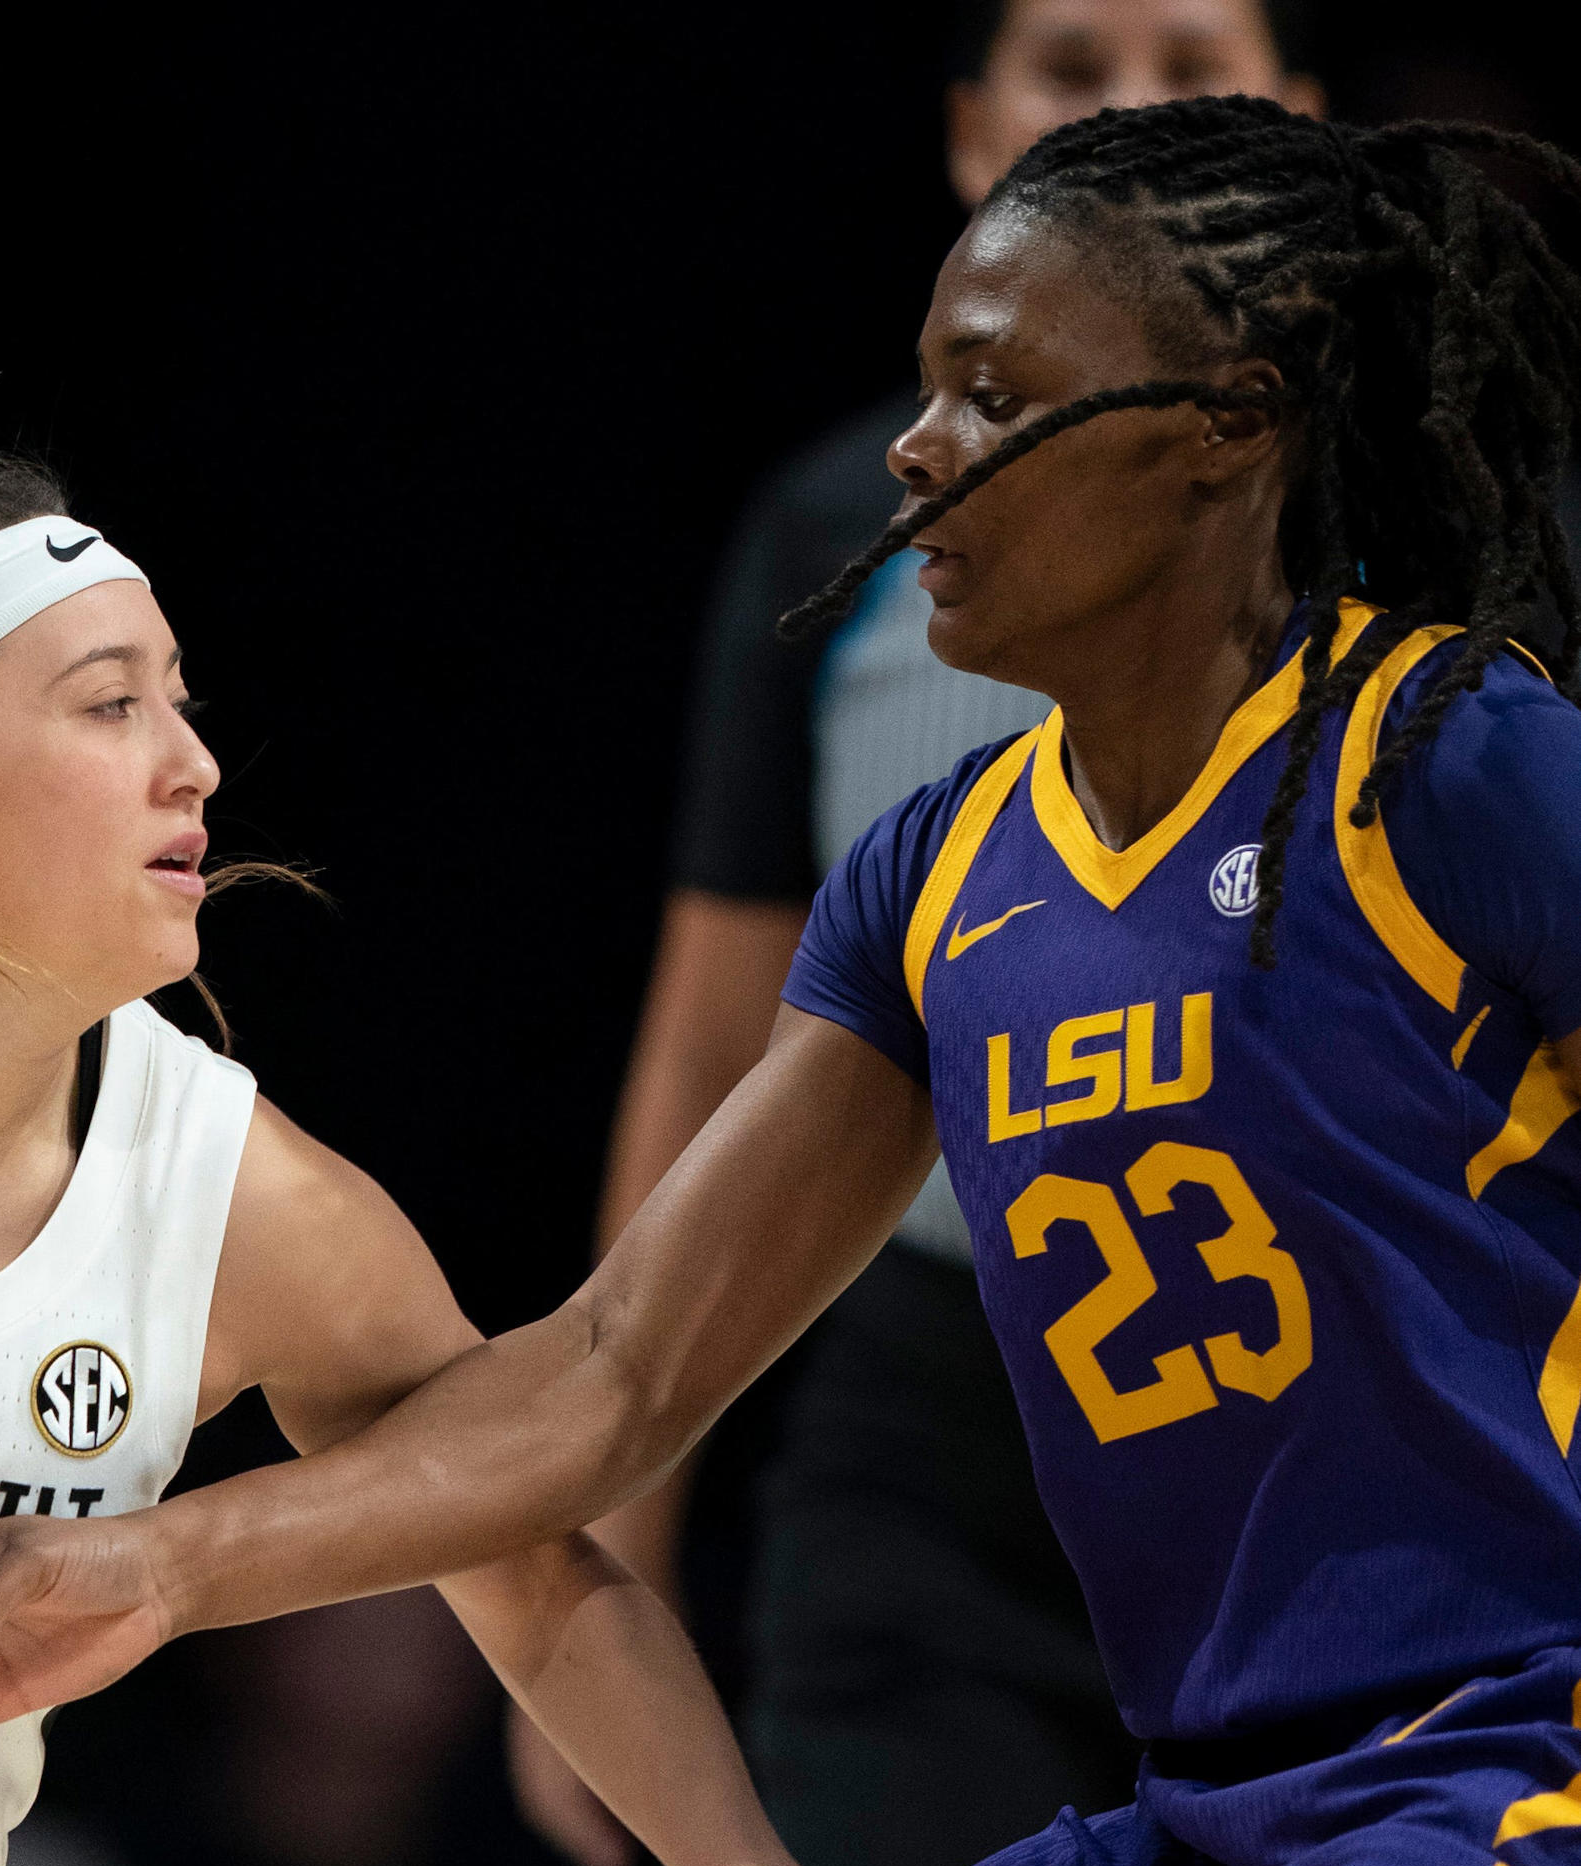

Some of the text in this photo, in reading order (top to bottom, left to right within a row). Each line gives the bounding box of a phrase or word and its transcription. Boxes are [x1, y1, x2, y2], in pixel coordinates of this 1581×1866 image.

[987, 992, 1214, 1143] LSU
[1005, 1141, 1313, 1443] 23
[41, 1347, 128, 1451] SEC
